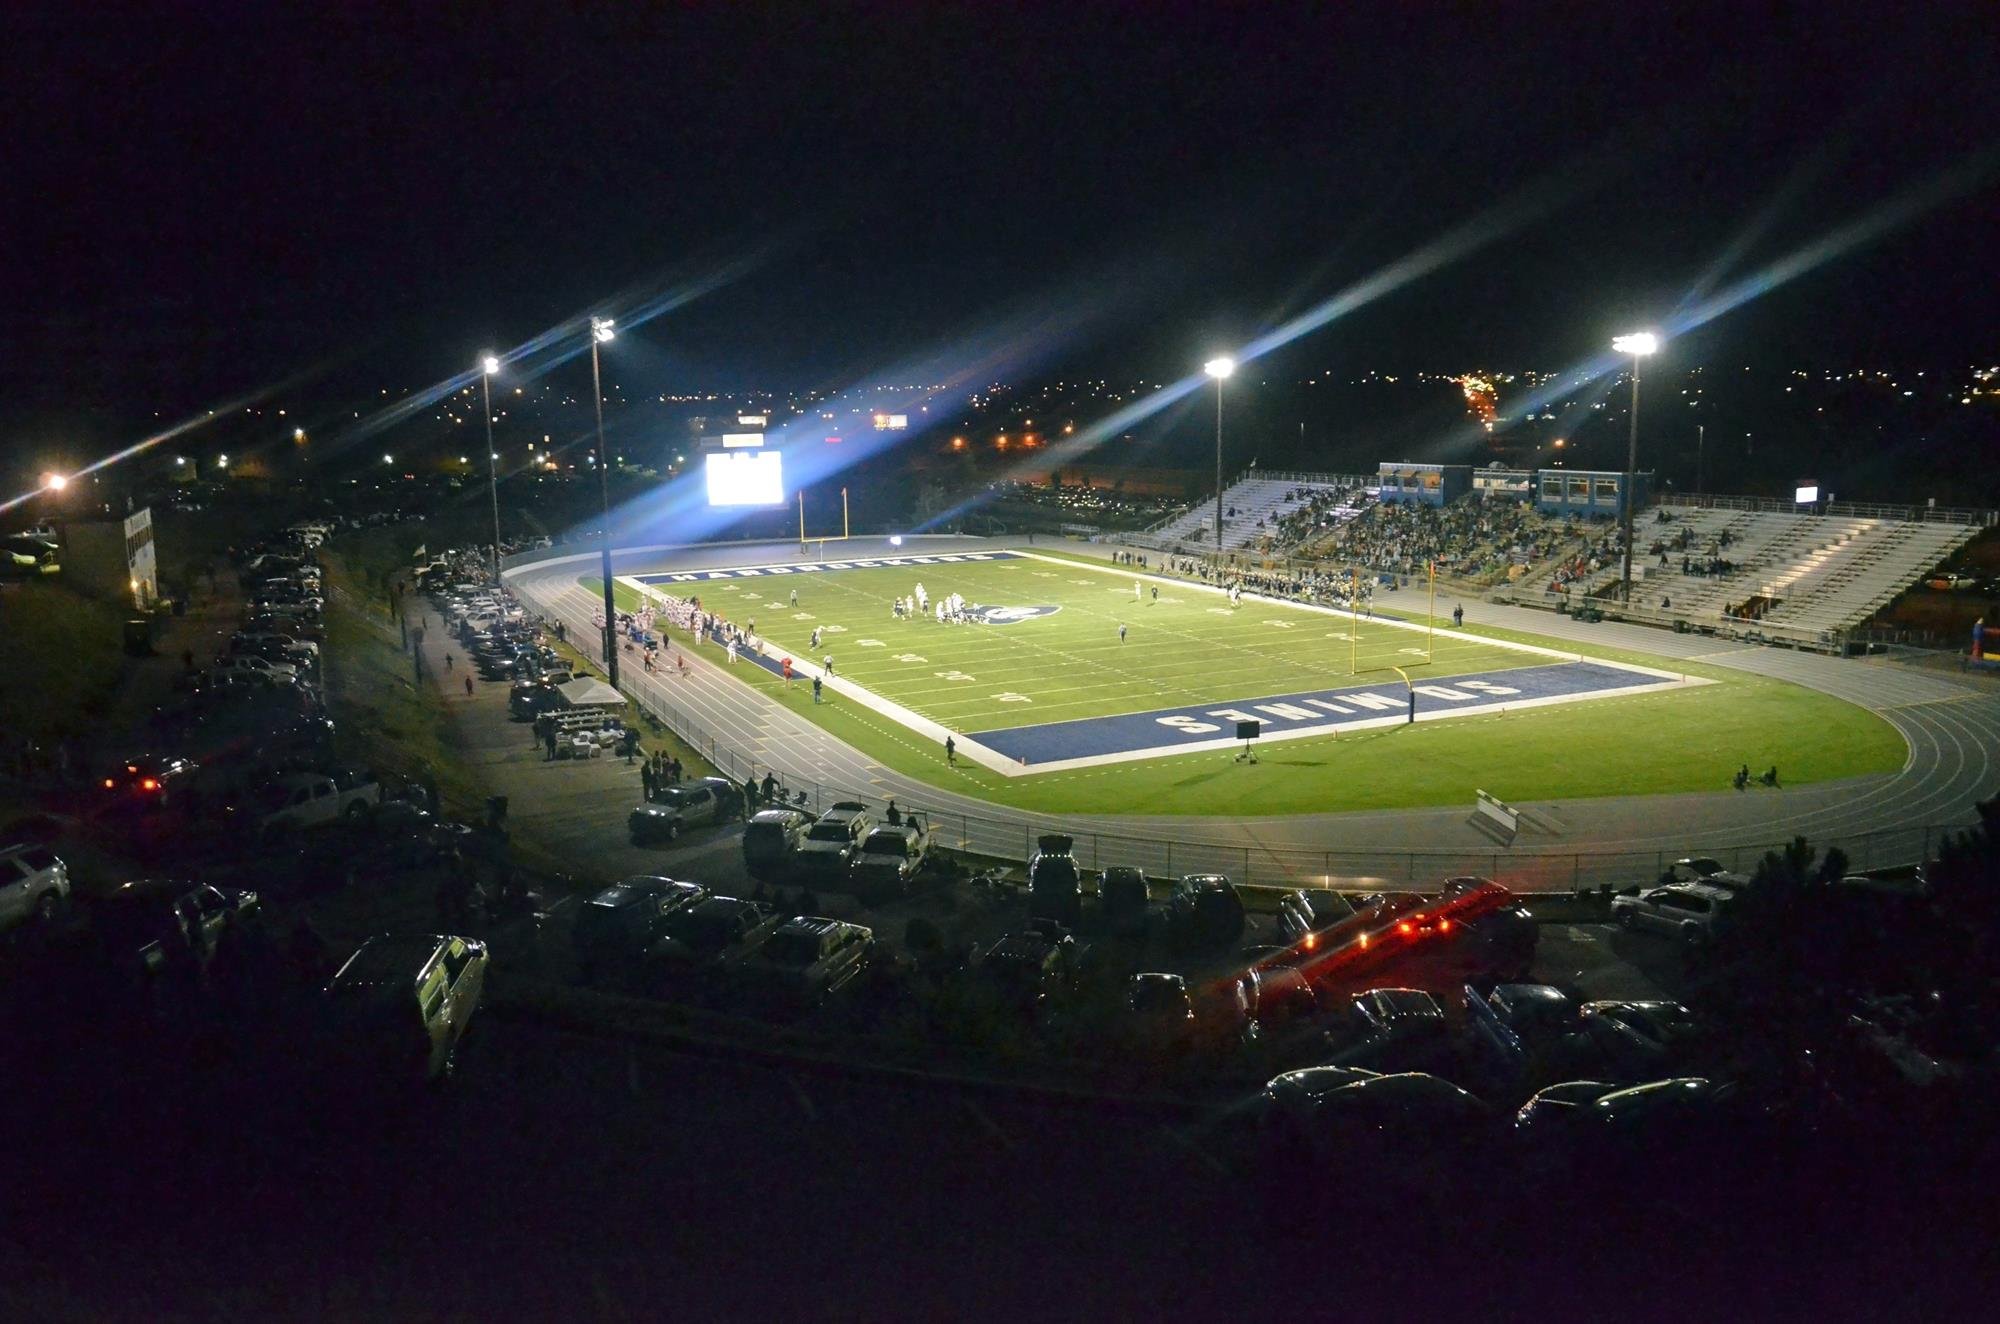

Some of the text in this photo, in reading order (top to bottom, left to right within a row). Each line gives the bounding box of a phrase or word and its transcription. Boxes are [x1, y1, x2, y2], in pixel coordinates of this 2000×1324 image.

[671, 555, 994, 582] HARDROCKERS
[1155, 680, 1522, 734] SD MINES
